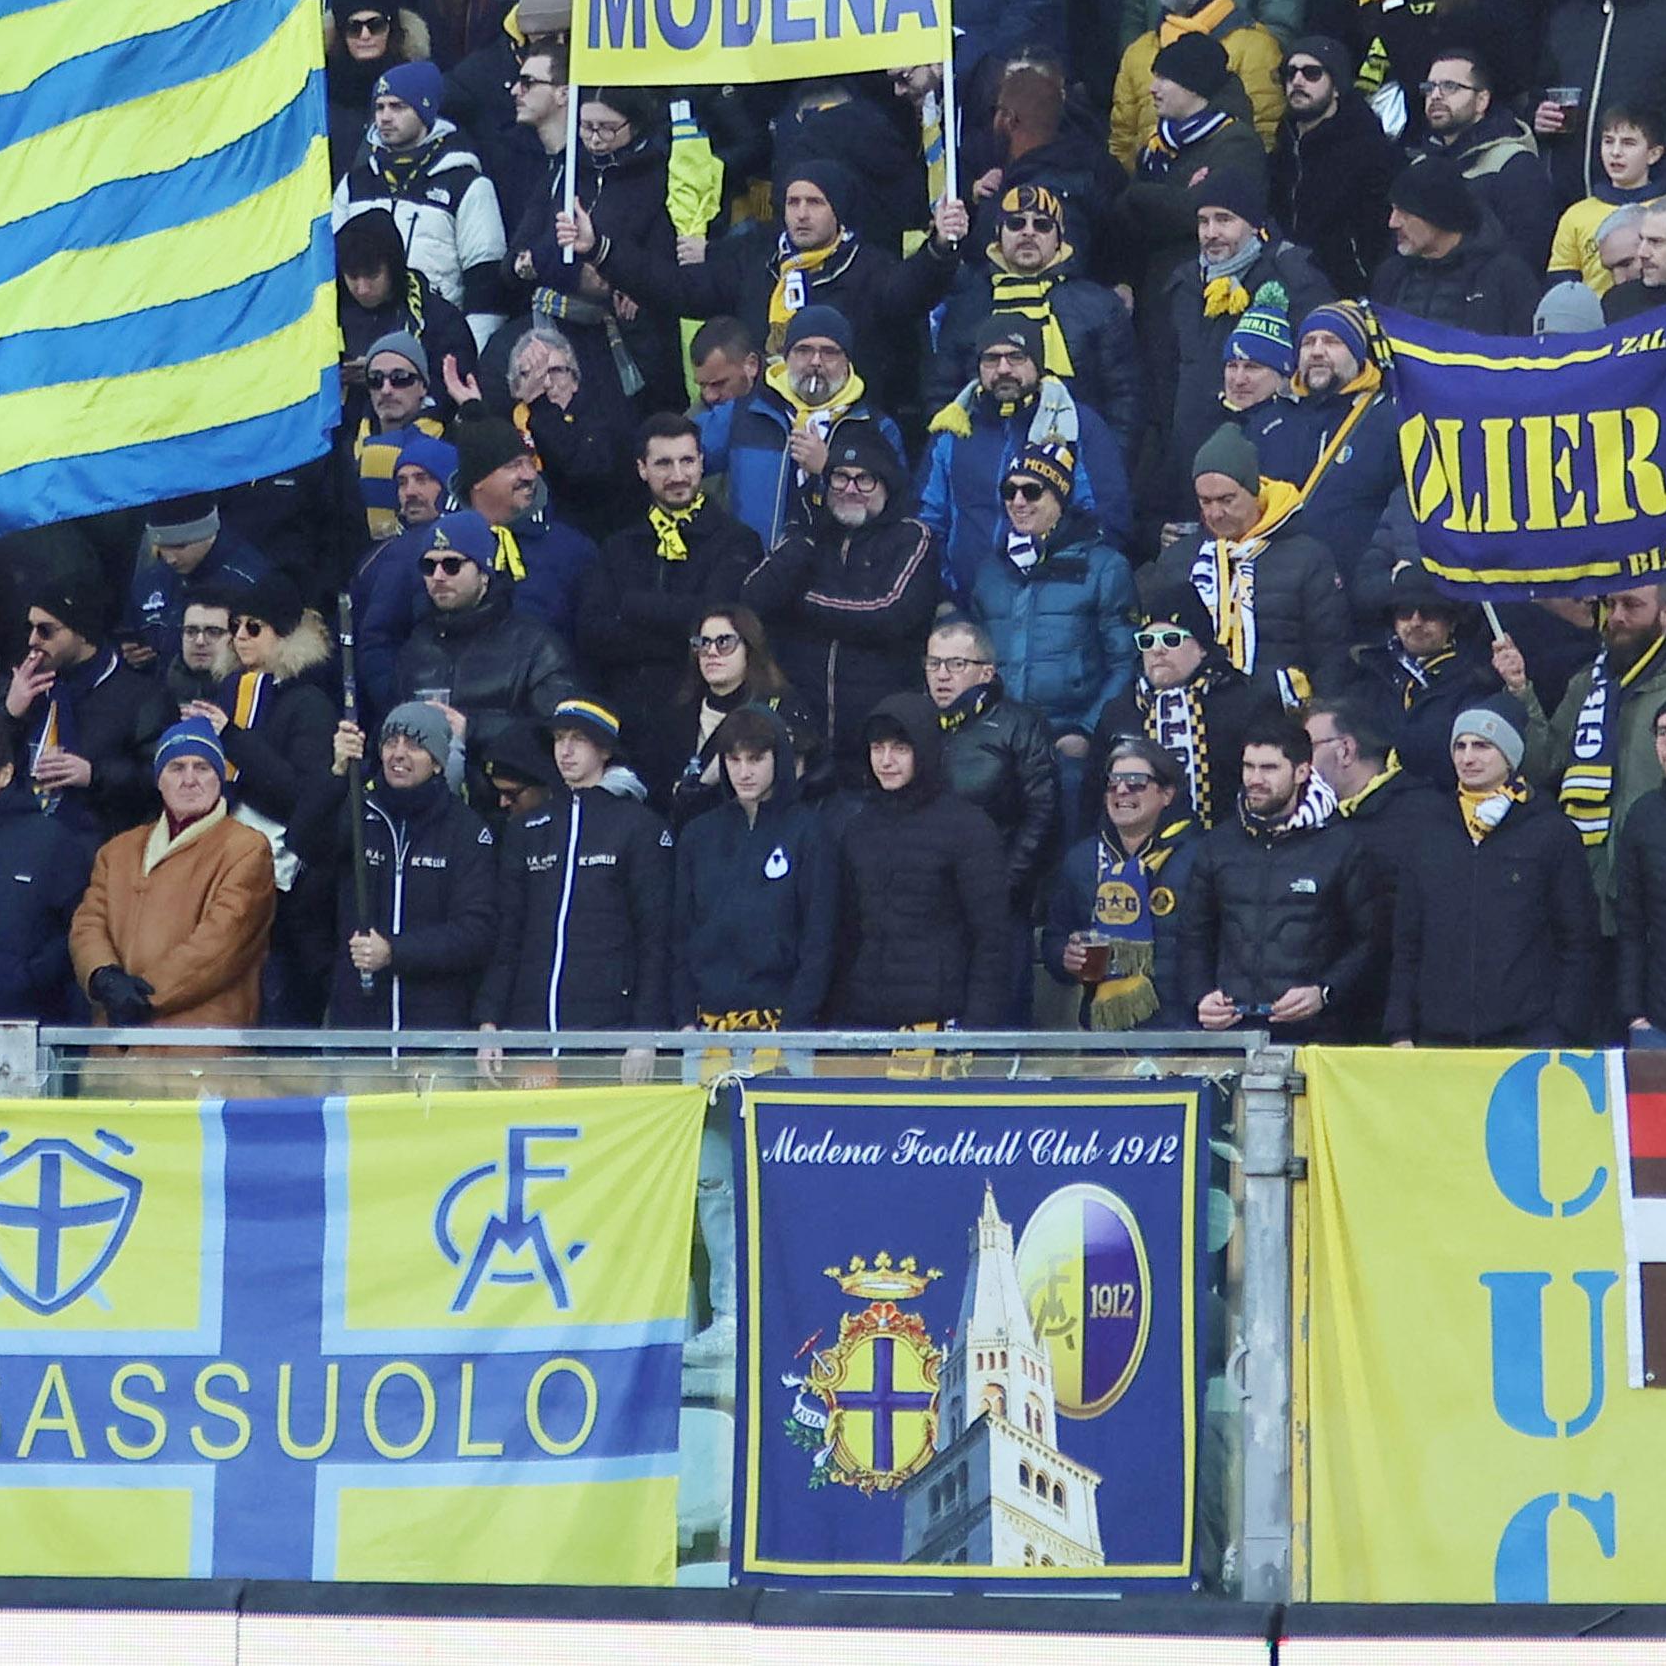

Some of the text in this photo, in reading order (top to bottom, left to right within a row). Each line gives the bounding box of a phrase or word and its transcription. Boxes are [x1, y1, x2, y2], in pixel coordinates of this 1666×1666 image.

[1616, 328, 1666, 357] ZAL
[762, 1127, 1180, 1166] Modena Football Club 1912
[1089, 1283, 1135, 1319] 1912
